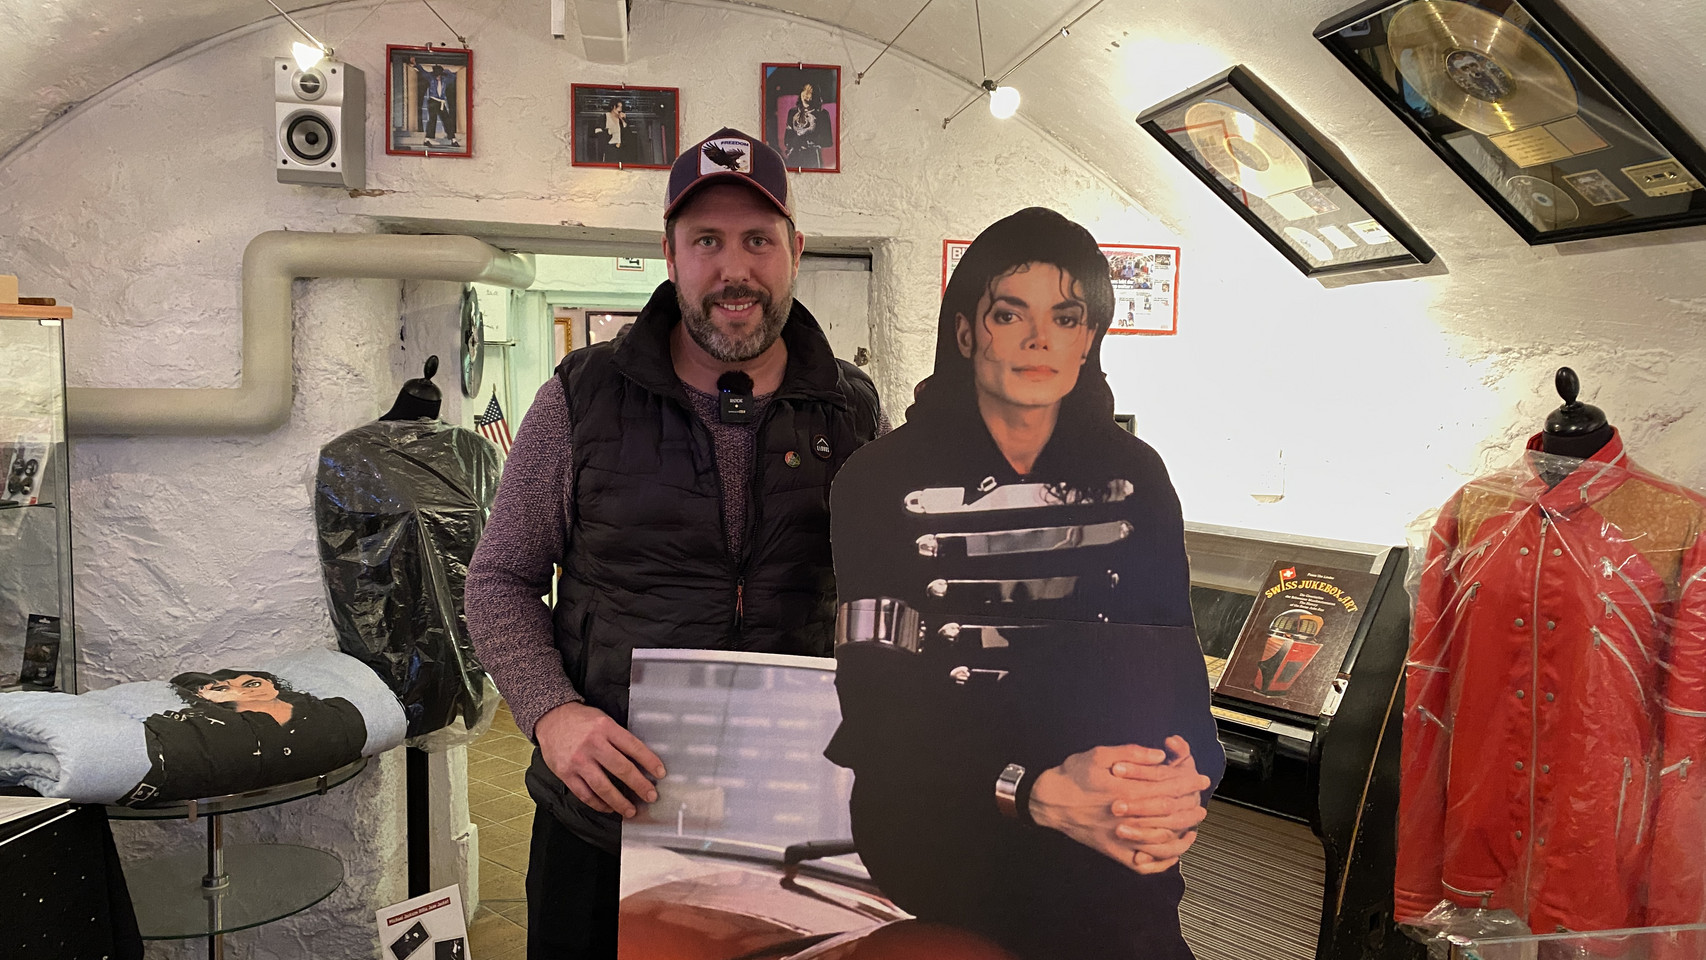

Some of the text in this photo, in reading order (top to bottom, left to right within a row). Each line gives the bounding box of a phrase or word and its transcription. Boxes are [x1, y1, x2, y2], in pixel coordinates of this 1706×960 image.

[1265, 579, 1298, 598] SWISS
[1298, 580, 1345, 601] JUKEBOX
[1338, 593, 1358, 612] ART
